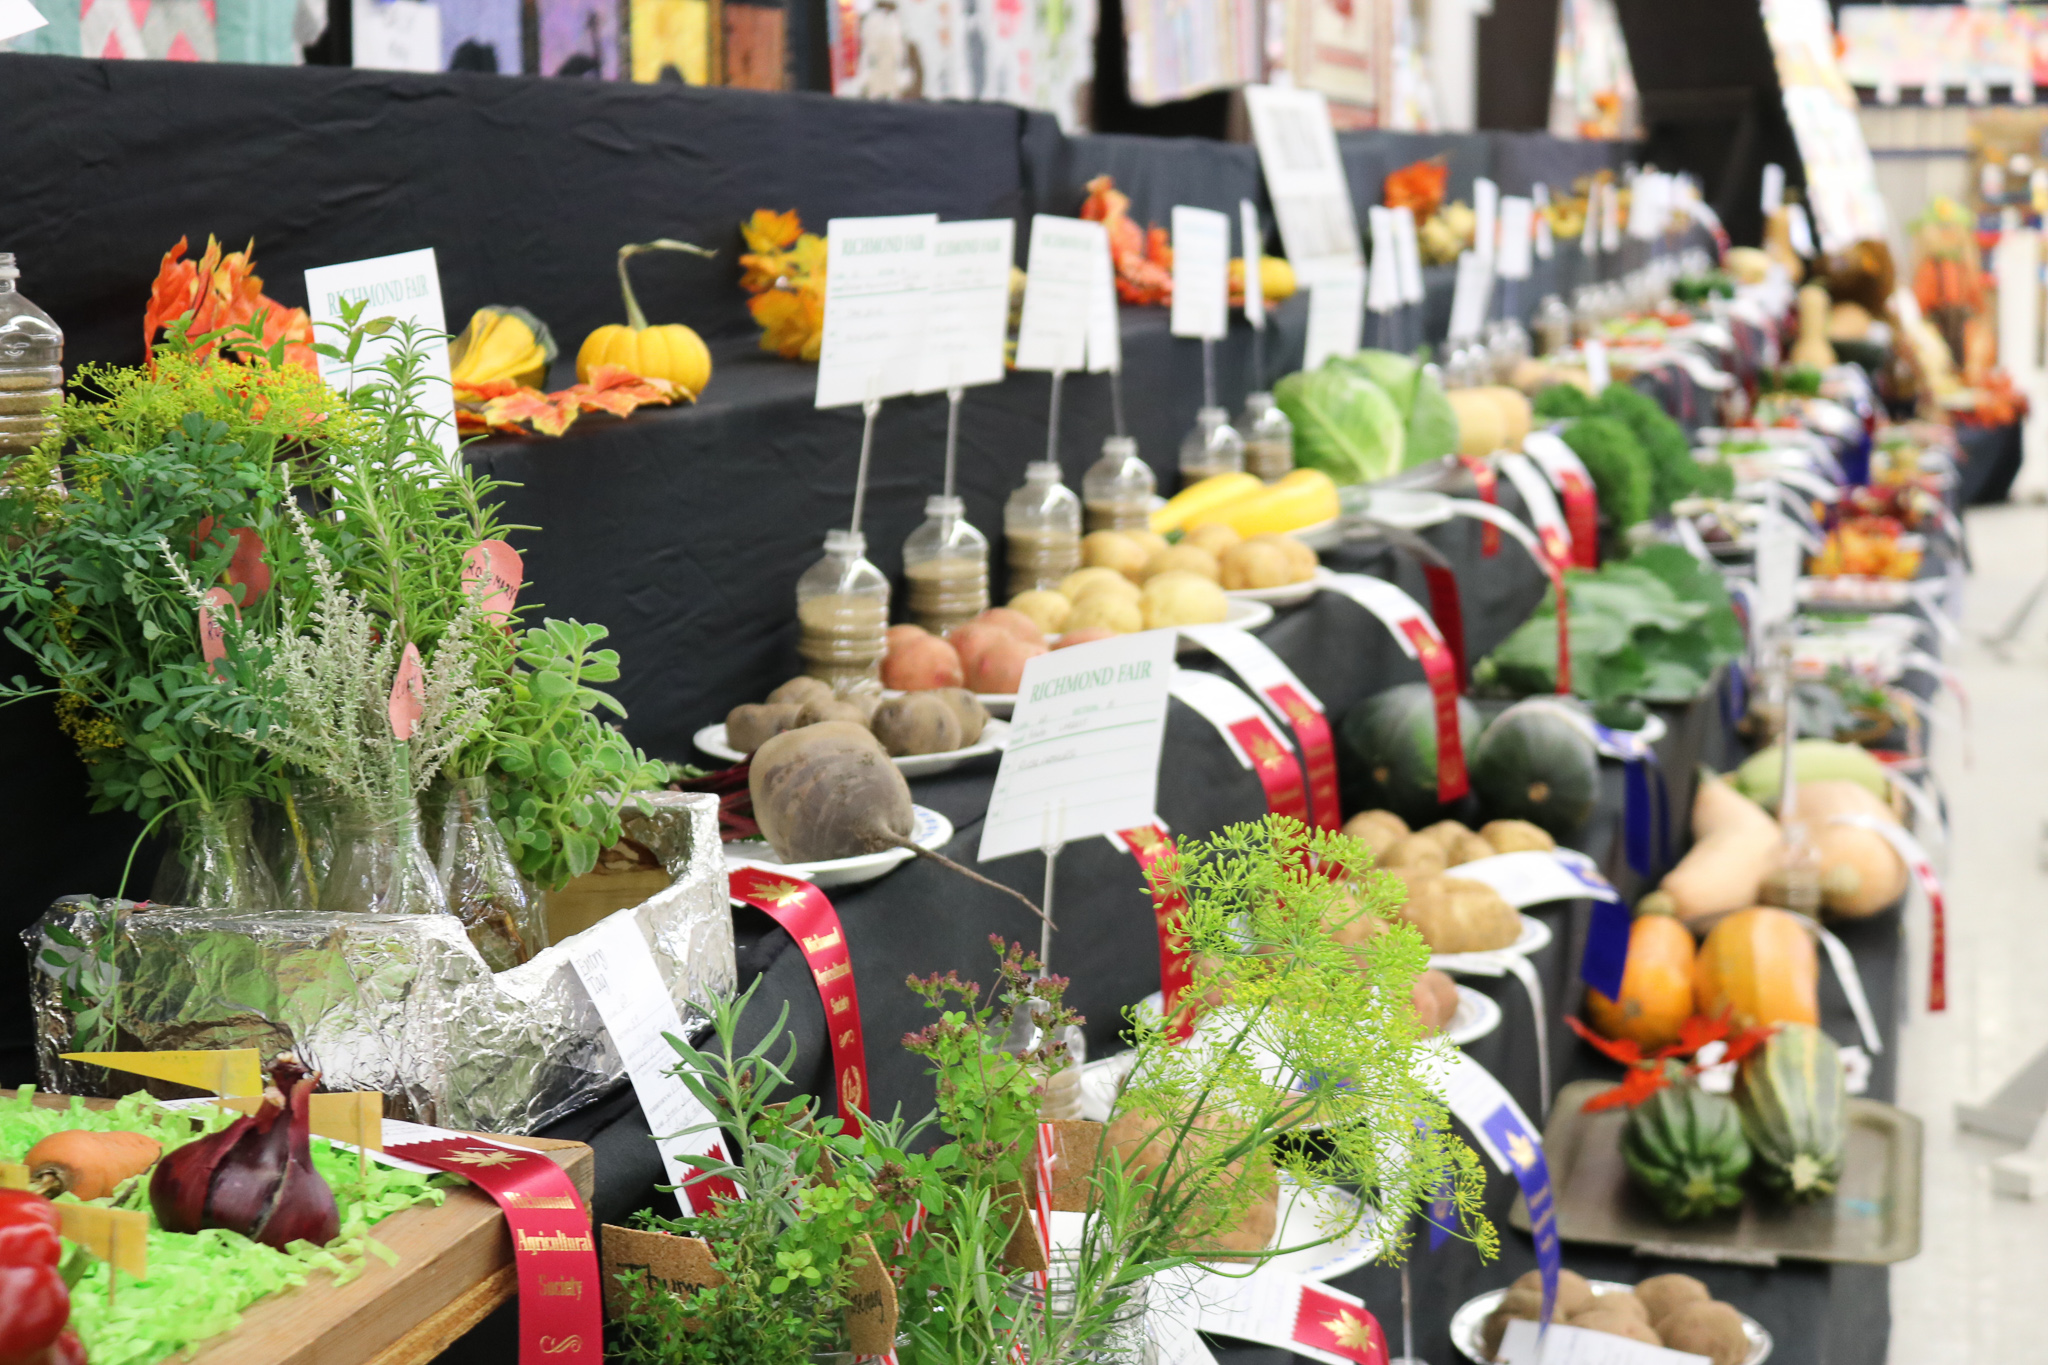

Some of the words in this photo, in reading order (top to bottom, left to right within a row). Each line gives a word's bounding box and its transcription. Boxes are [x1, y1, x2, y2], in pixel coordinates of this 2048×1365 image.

[404, 274, 429, 300] FAIR
[1029, 667, 1114, 703] RICHMOND
[1117, 660, 1152, 684] FAIR
[575, 948, 608, 976] Entry
[586, 973, 611, 996] Tag
[502, 1190, 577, 1210] Richmond
[517, 1228, 594, 1256] Agricultural
[538, 1274, 583, 1301] Society
